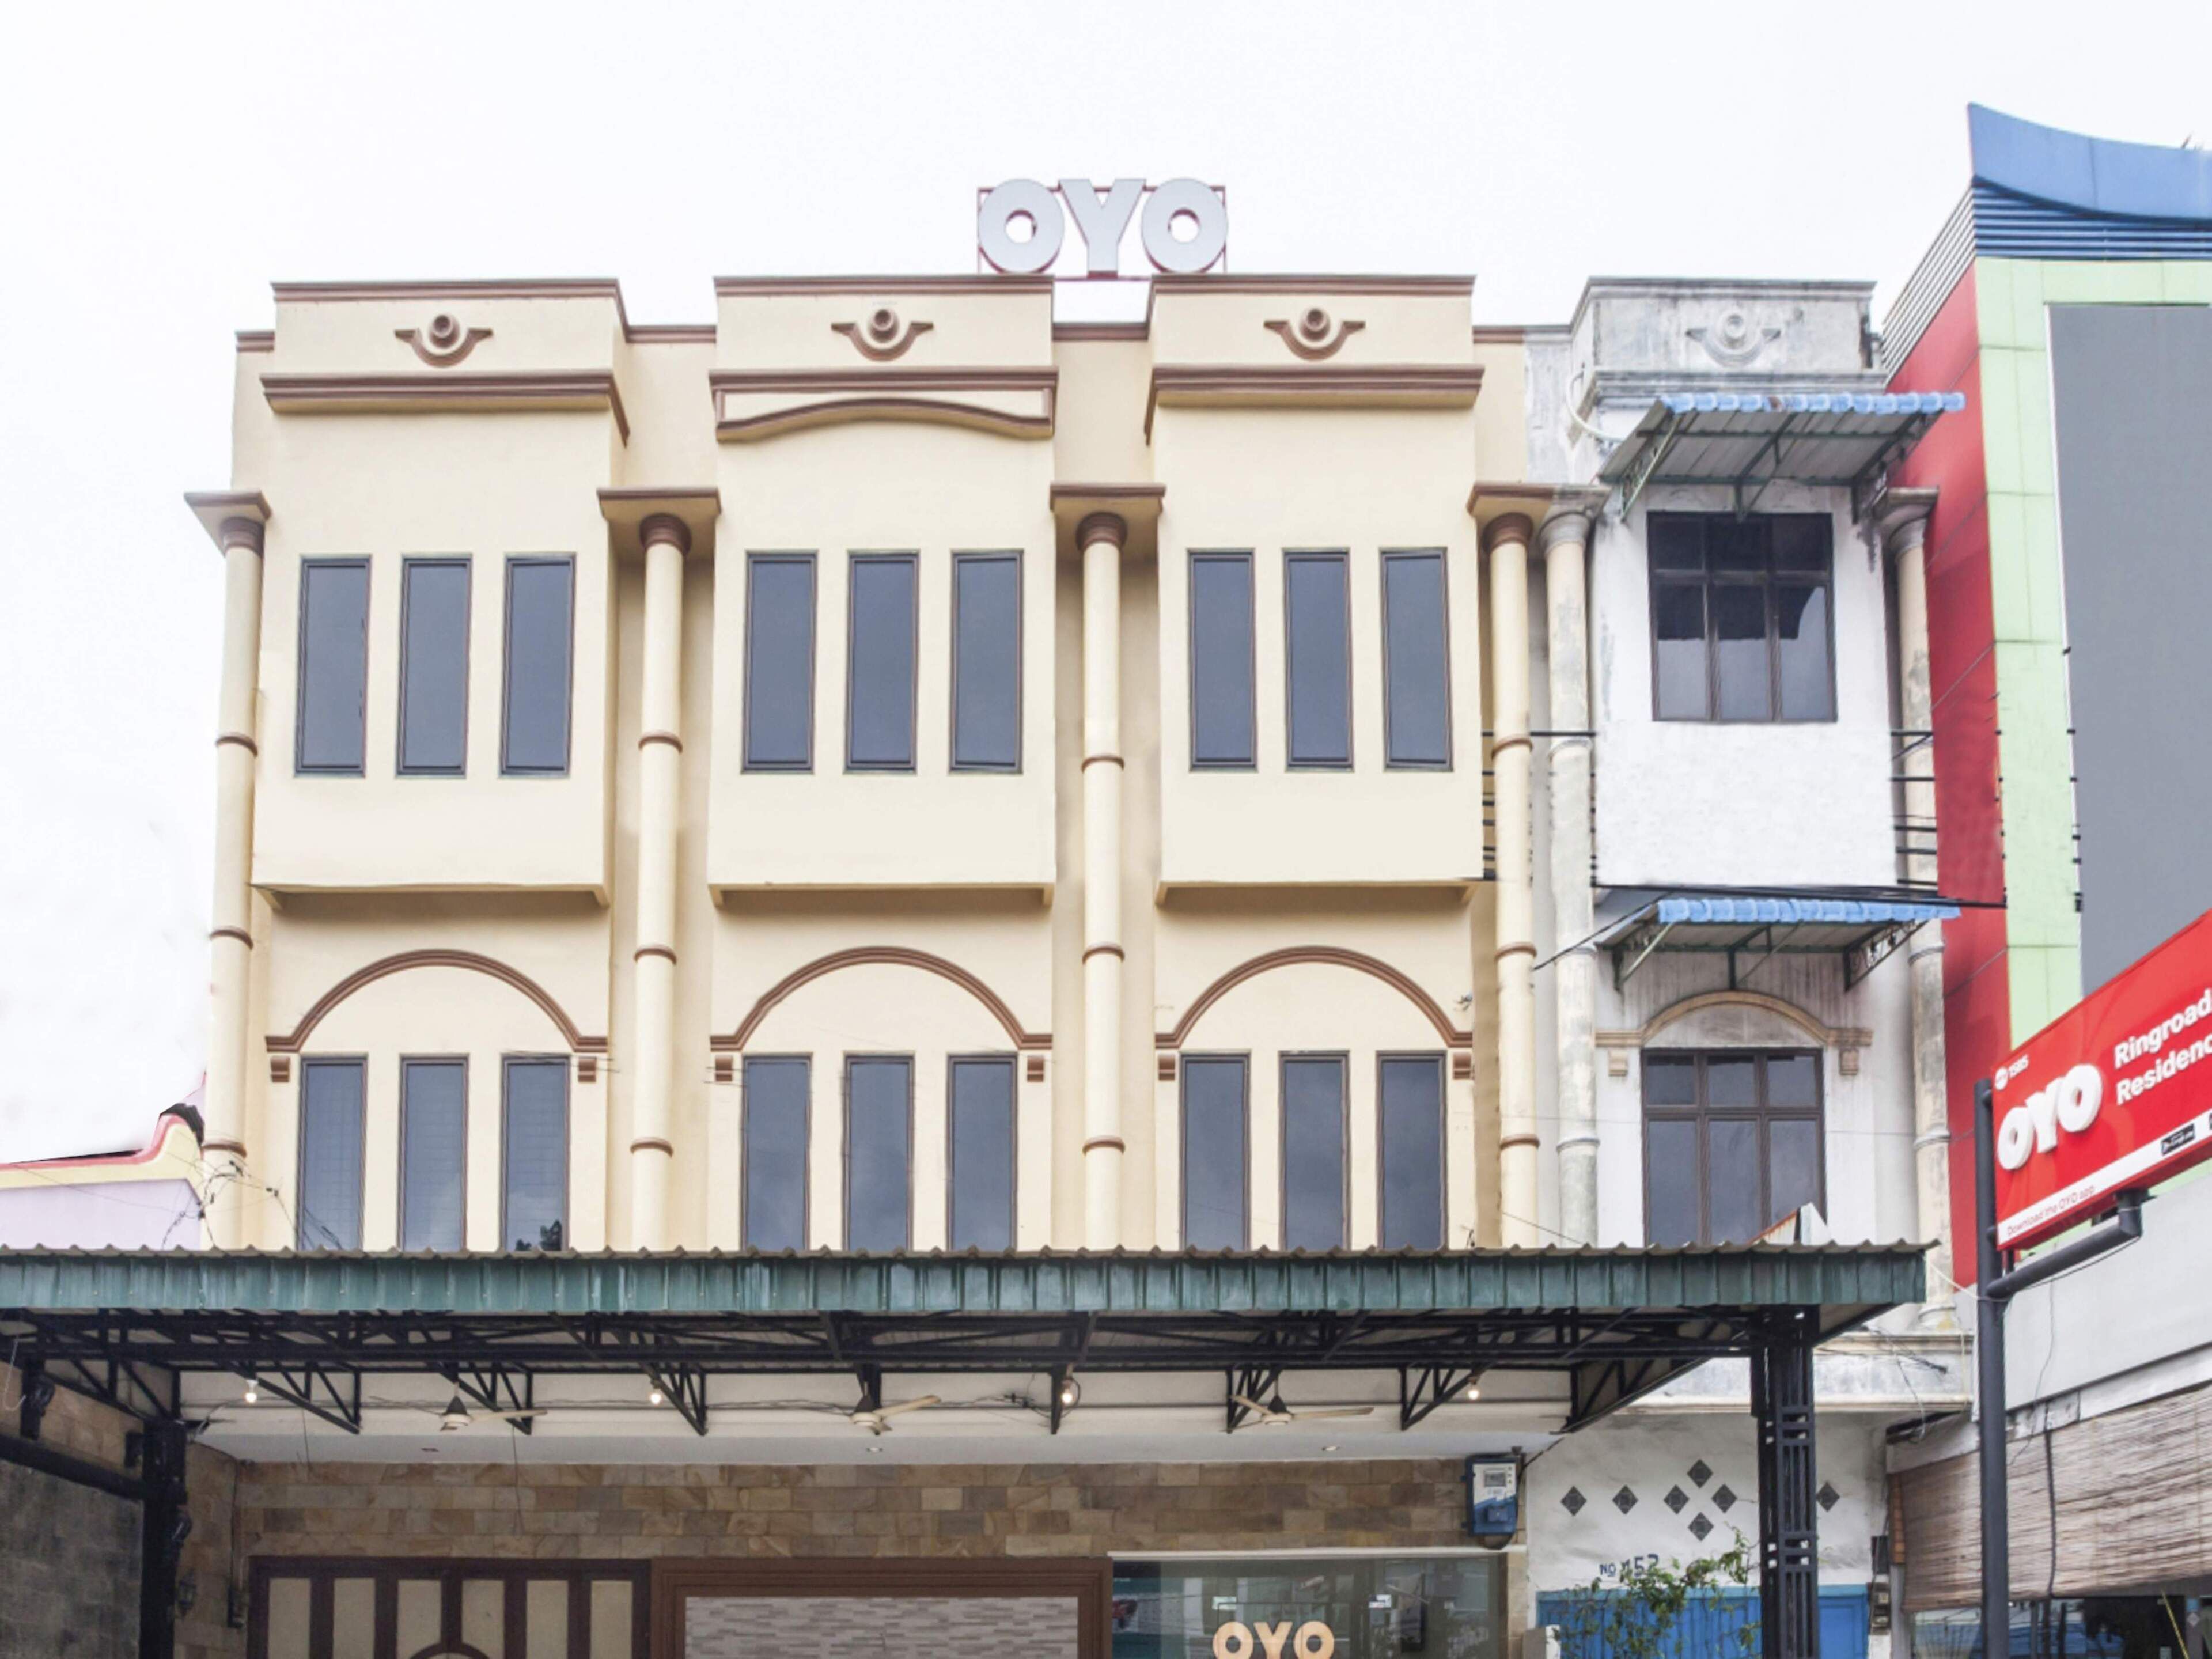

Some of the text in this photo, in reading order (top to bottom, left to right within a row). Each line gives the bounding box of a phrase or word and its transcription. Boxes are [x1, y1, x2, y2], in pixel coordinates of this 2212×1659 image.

[978, 177, 1228, 279] OYO
[2114, 987, 2212, 1069] Ringroad
[1998, 1063, 2103, 1171] OYO
[1212, 1620, 1335, 1659] OYO
